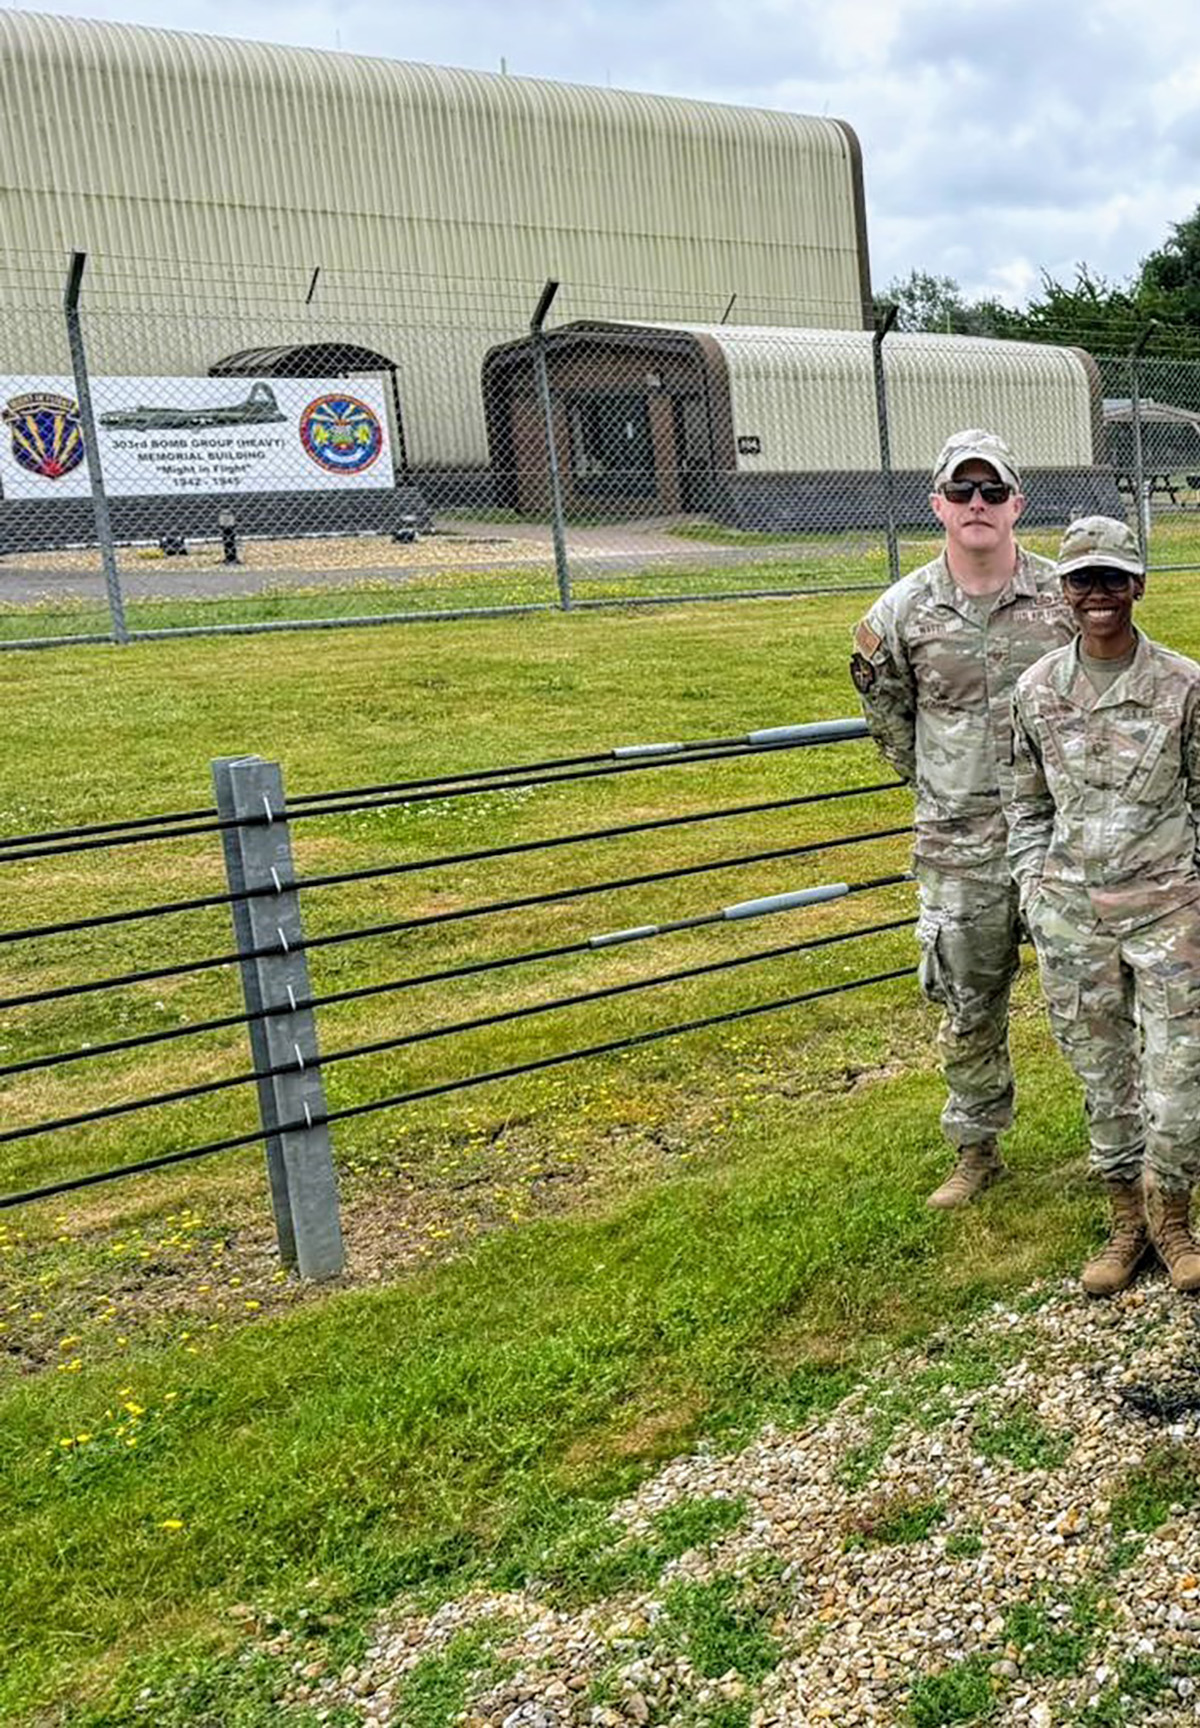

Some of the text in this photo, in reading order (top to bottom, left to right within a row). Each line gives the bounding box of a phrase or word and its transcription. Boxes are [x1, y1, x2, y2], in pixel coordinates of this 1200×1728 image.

[112, 438, 286, 449] 303rd BOMB GROUP (HEAVY)
[138, 451, 266, 461] MEMORIAL BUILDING
[199, 465, 210, 473] in
[173, 477, 201, 486] 1942
[212, 476, 241, 486] 1945
